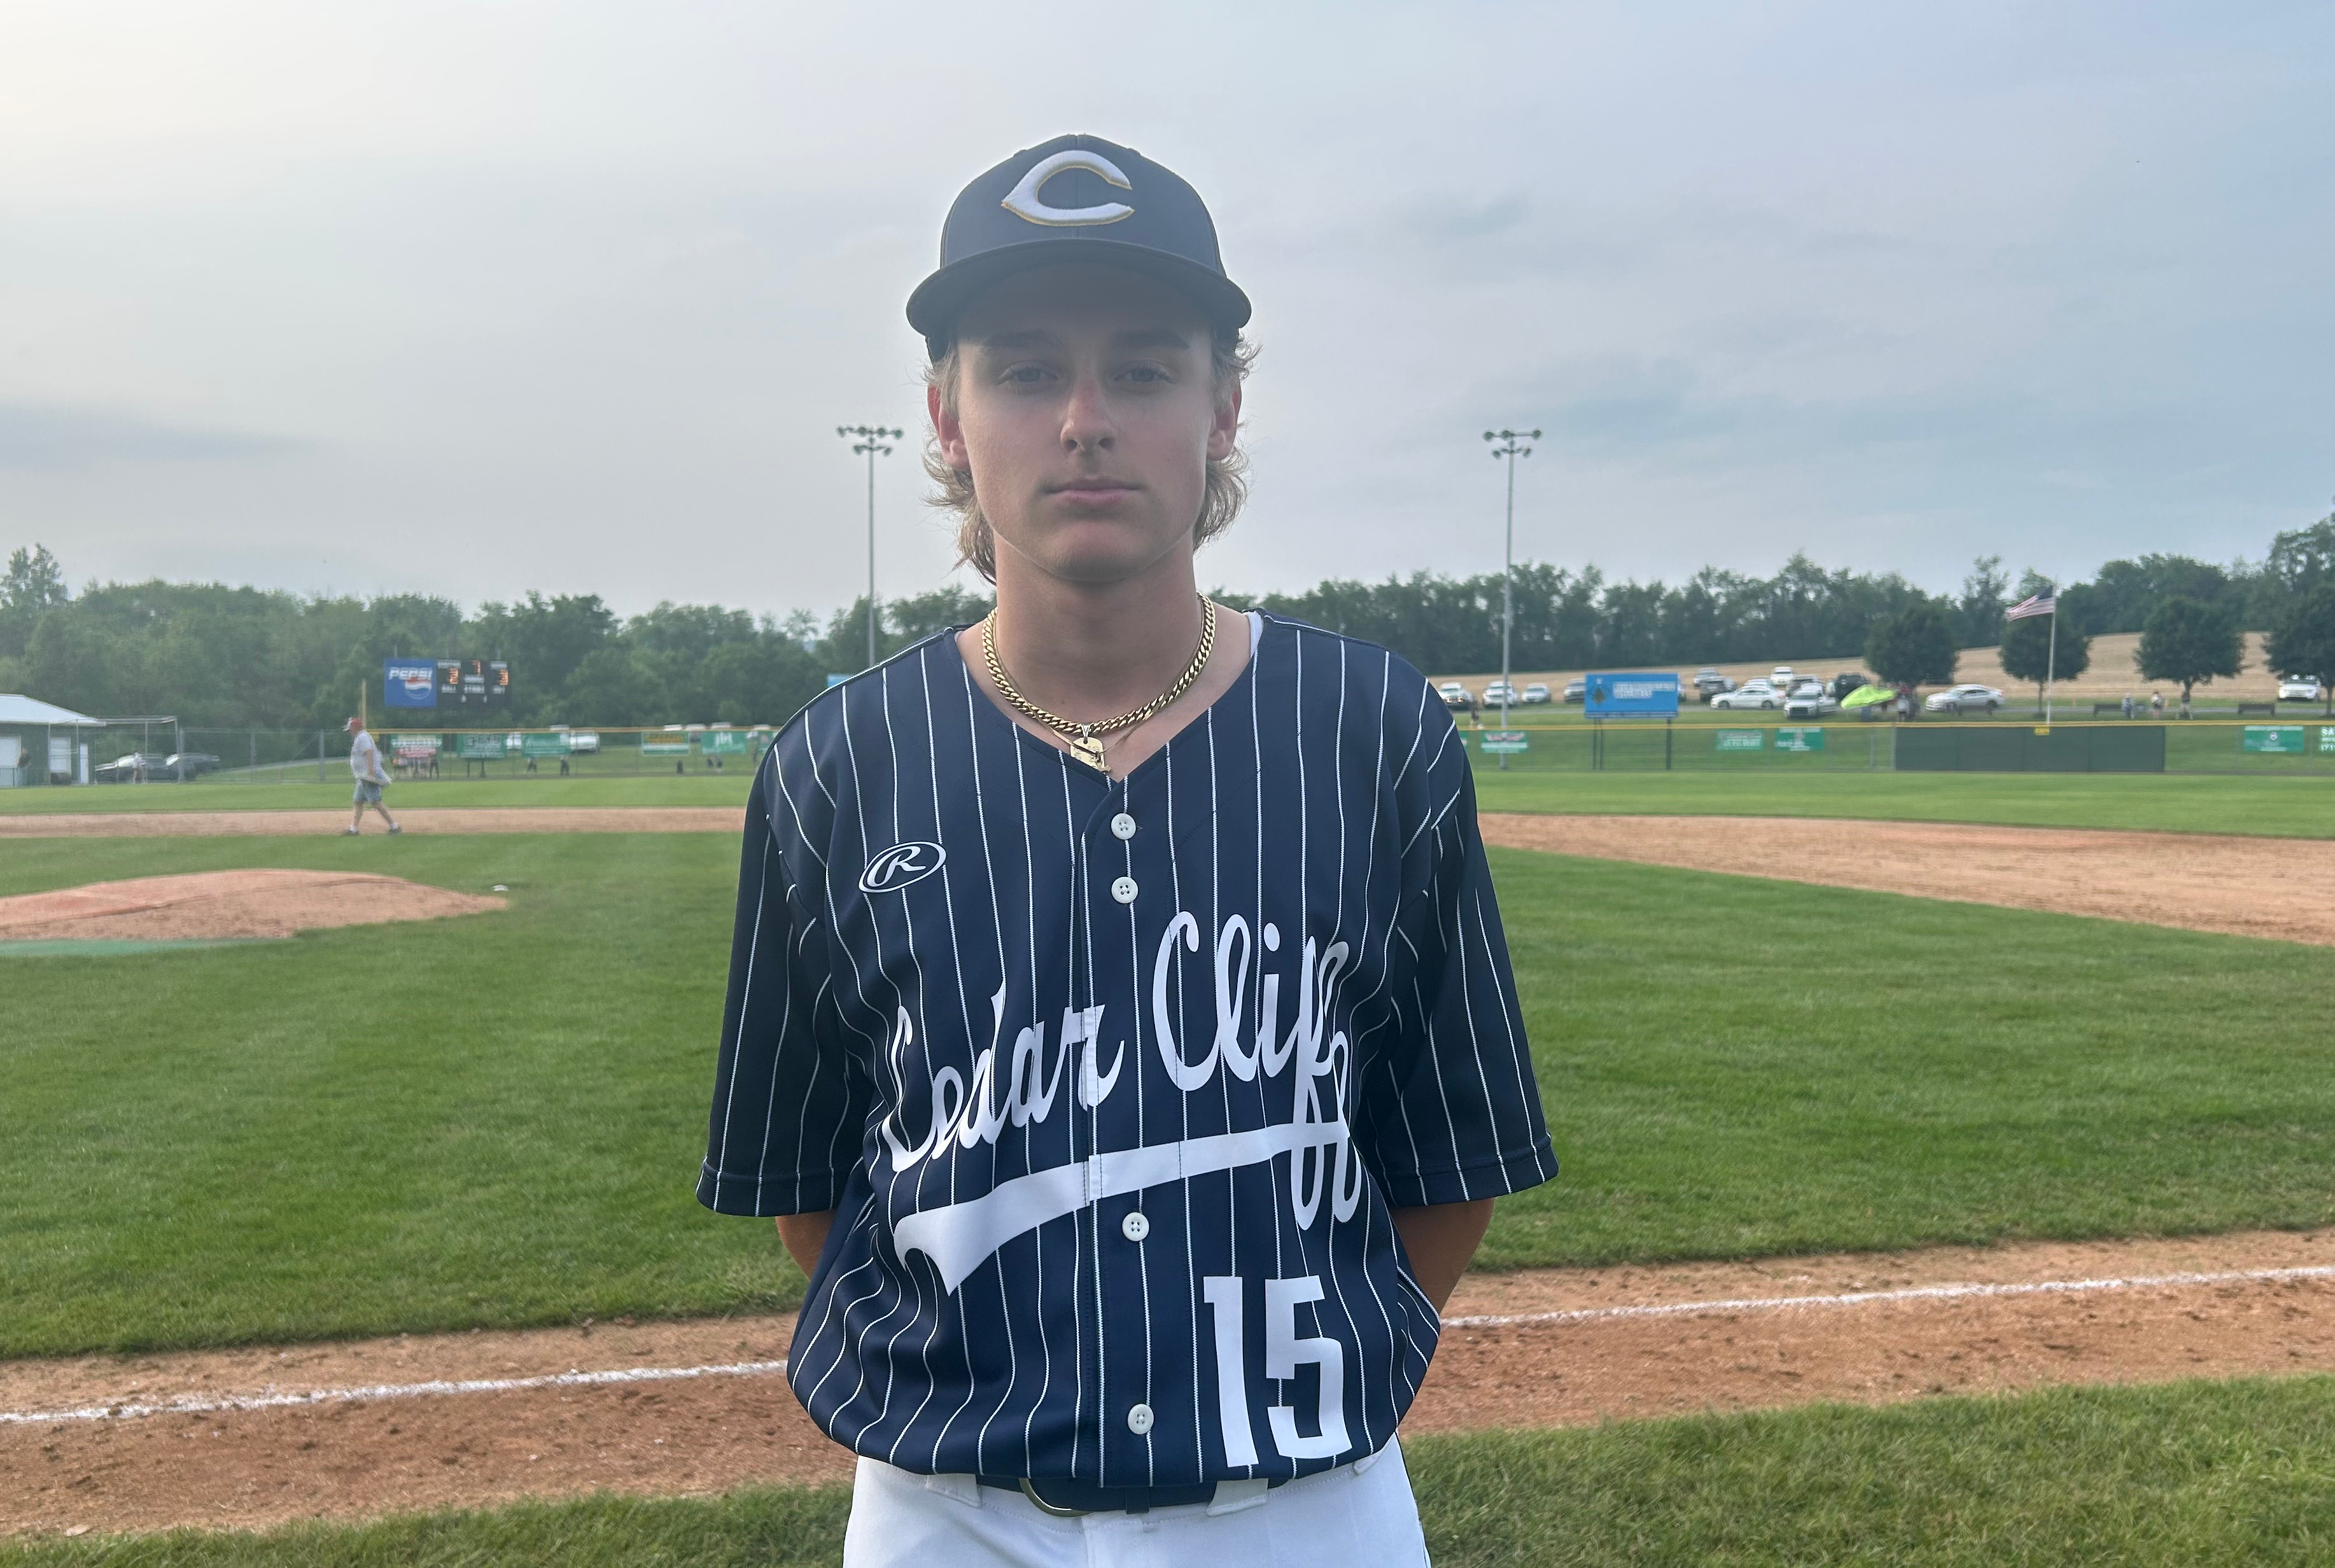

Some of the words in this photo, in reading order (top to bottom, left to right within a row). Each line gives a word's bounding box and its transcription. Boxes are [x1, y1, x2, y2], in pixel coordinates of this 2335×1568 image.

[1001, 150, 1135, 227] C
[388, 667, 433, 680] PEPSI
[867, 846, 927, 887] R
[882, 979, 1125, 1172] Cedar
[1153, 911, 1362, 1231] Cliff
[1203, 1275, 1352, 1468] 15
